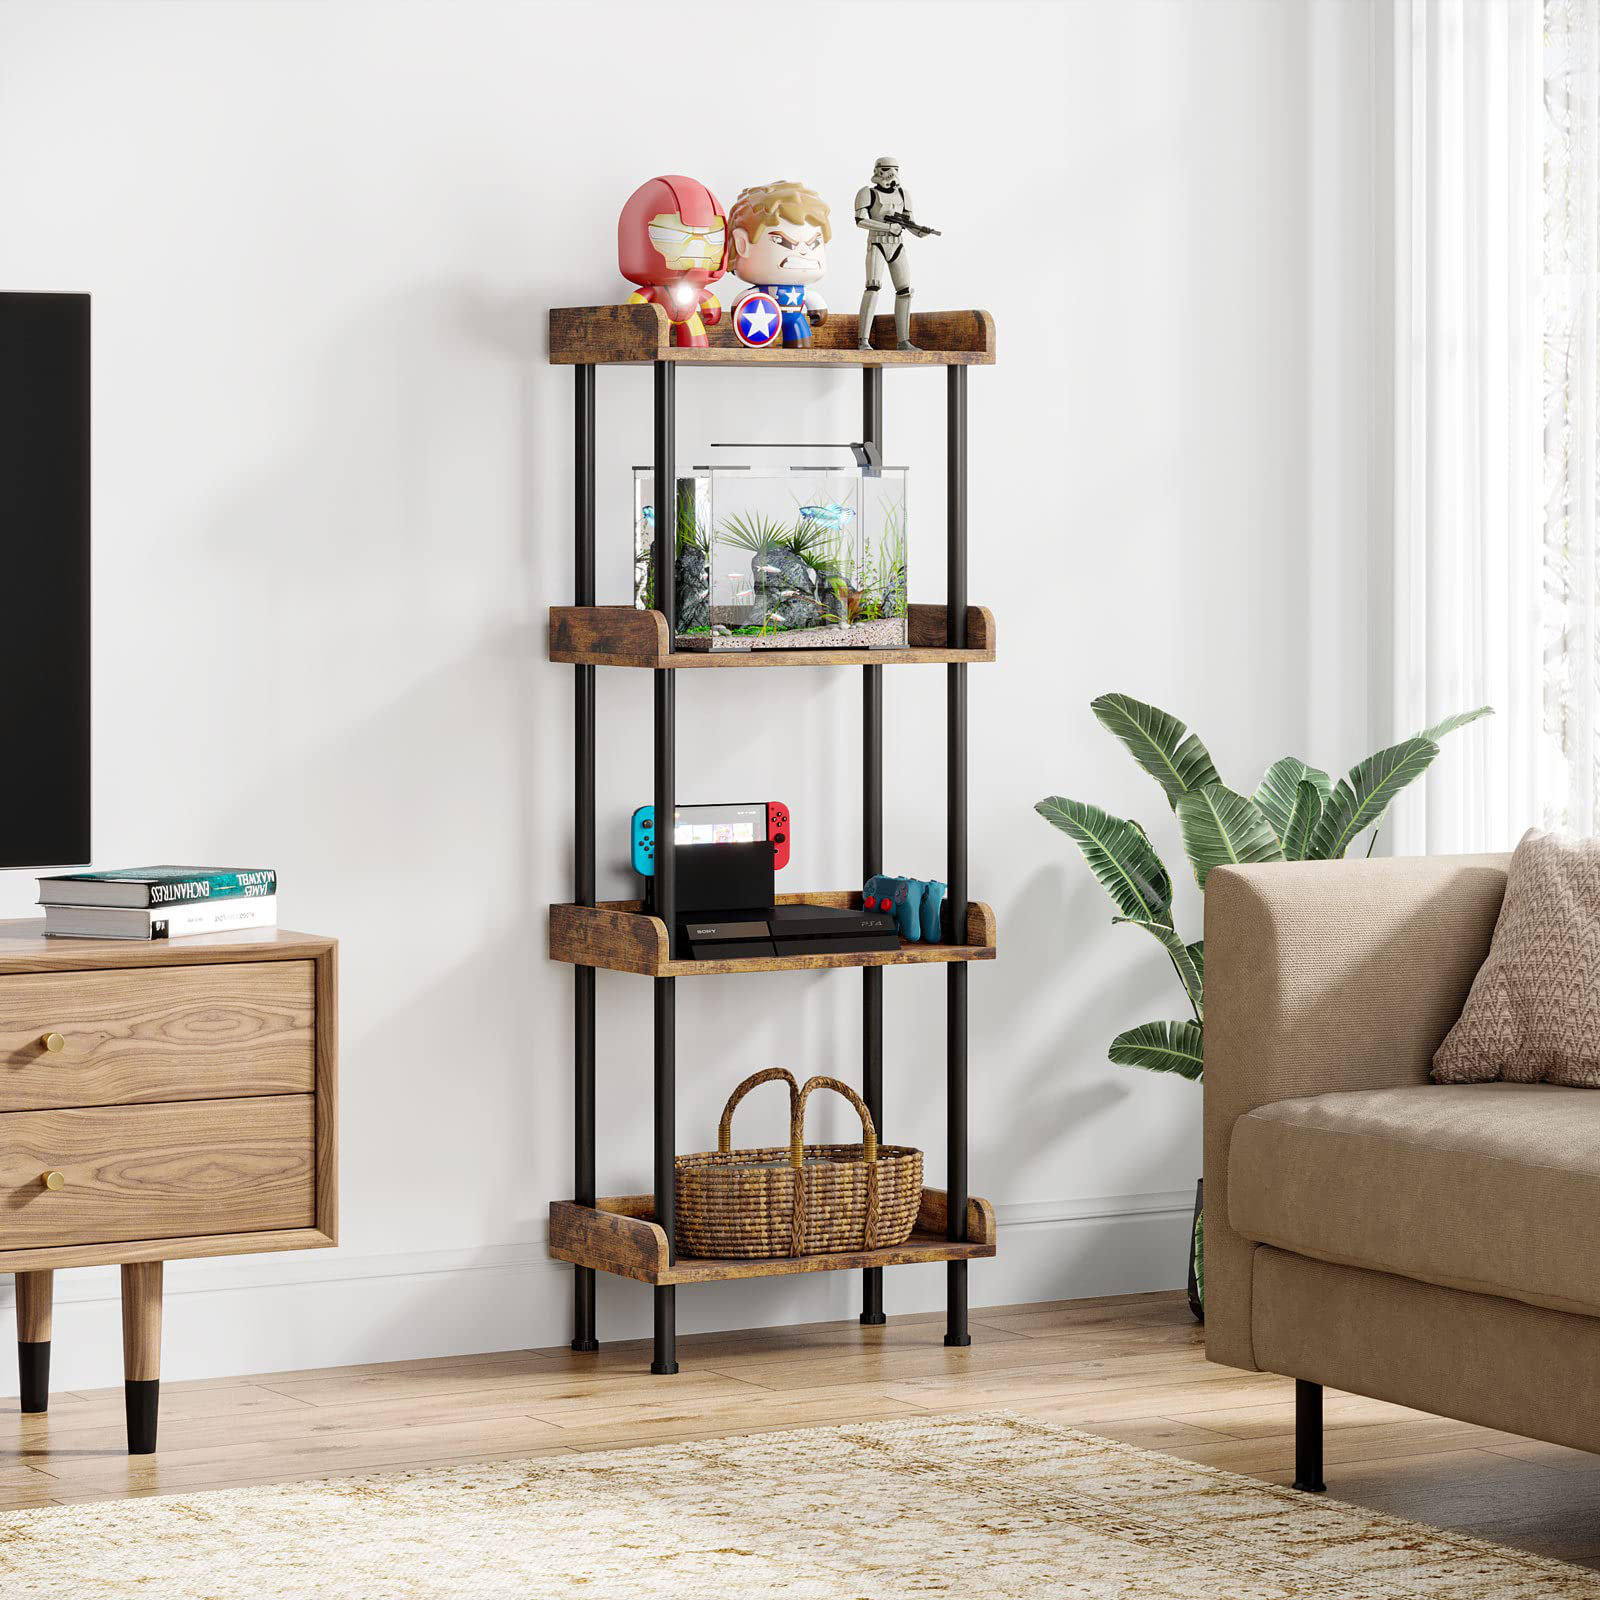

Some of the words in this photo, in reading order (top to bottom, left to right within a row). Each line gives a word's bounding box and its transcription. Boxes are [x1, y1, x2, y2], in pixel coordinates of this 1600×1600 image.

[236, 871, 275, 886] MAXWELL
[151, 881, 209, 903] ENCHANTRESS
[244, 882, 268, 897] JAMES
